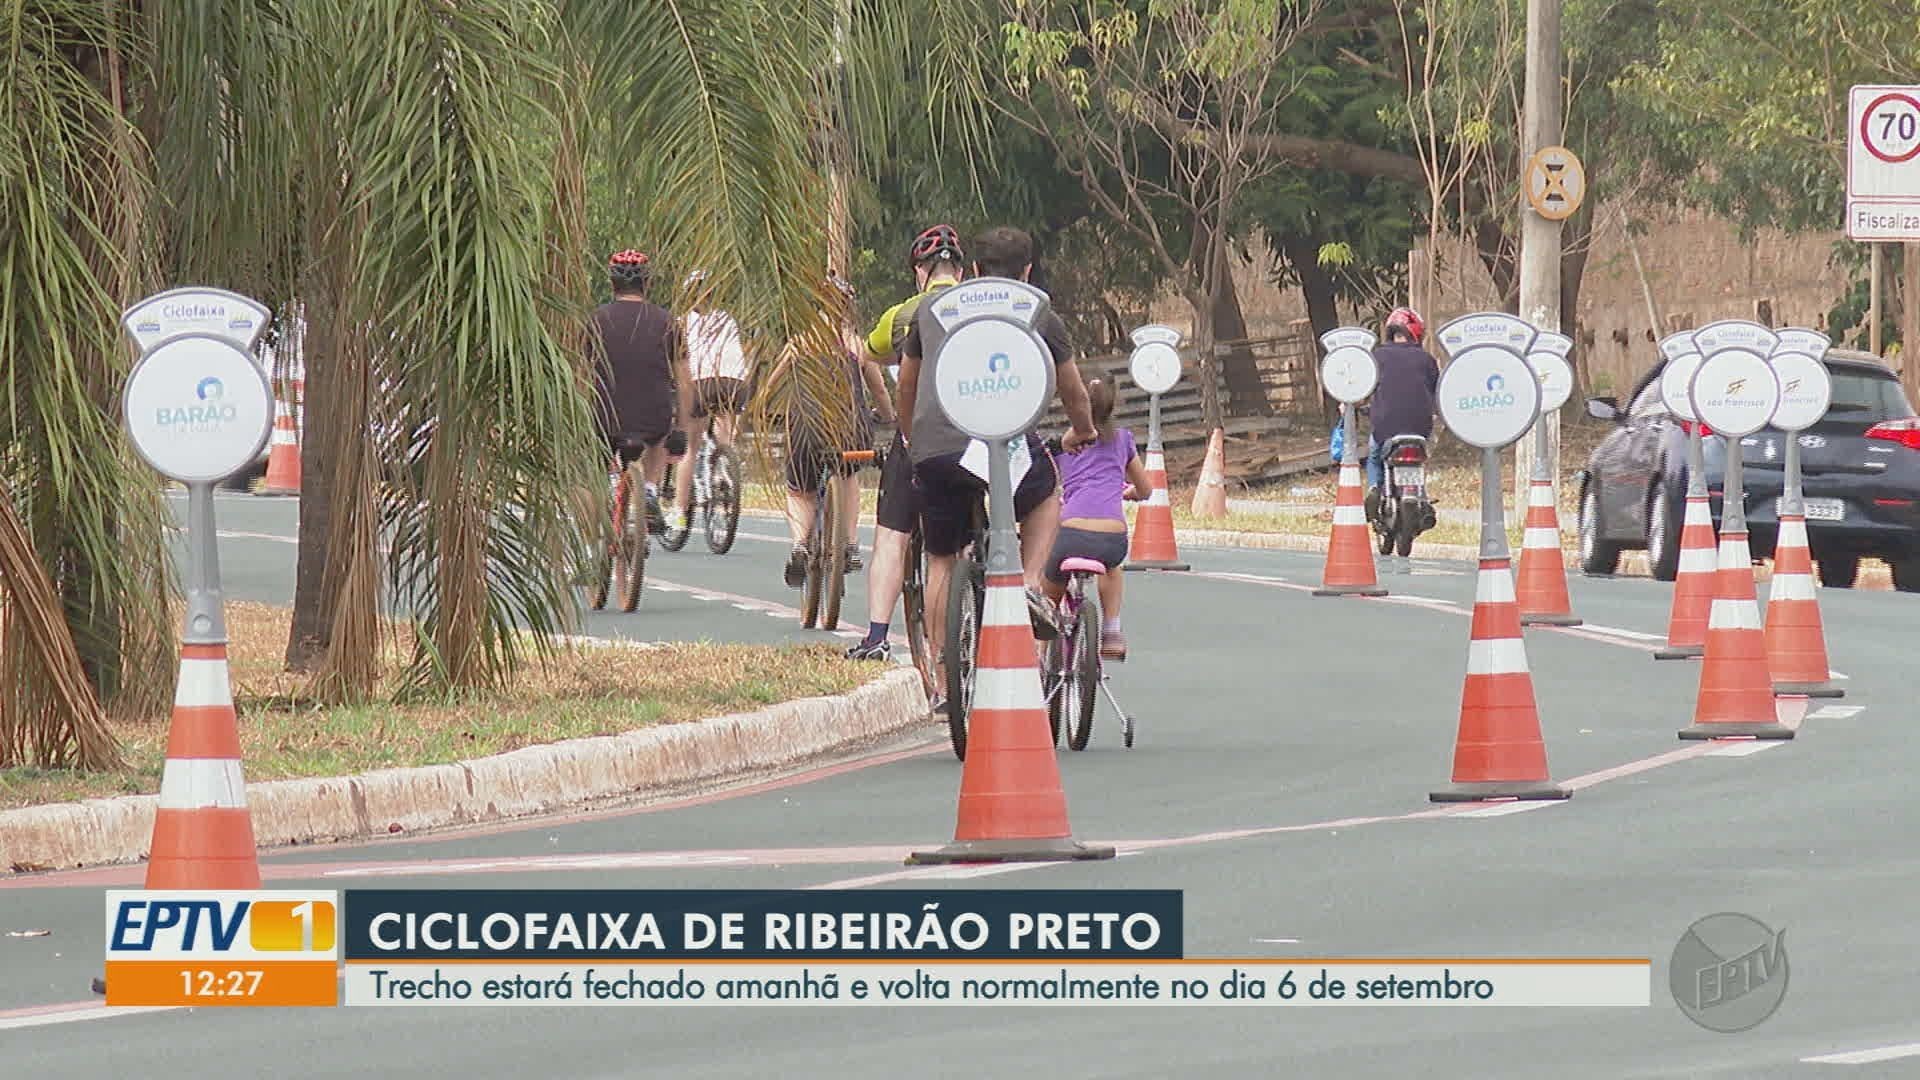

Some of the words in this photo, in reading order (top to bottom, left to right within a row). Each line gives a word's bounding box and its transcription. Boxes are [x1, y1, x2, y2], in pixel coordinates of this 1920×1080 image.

[1879, 113, 1915, 140] 70
[1858, 211, 1920, 229] Fiscaliza
[959, 289, 1009, 305] Ciclofaixa
[162, 303, 225, 318] Ciclofaixa
